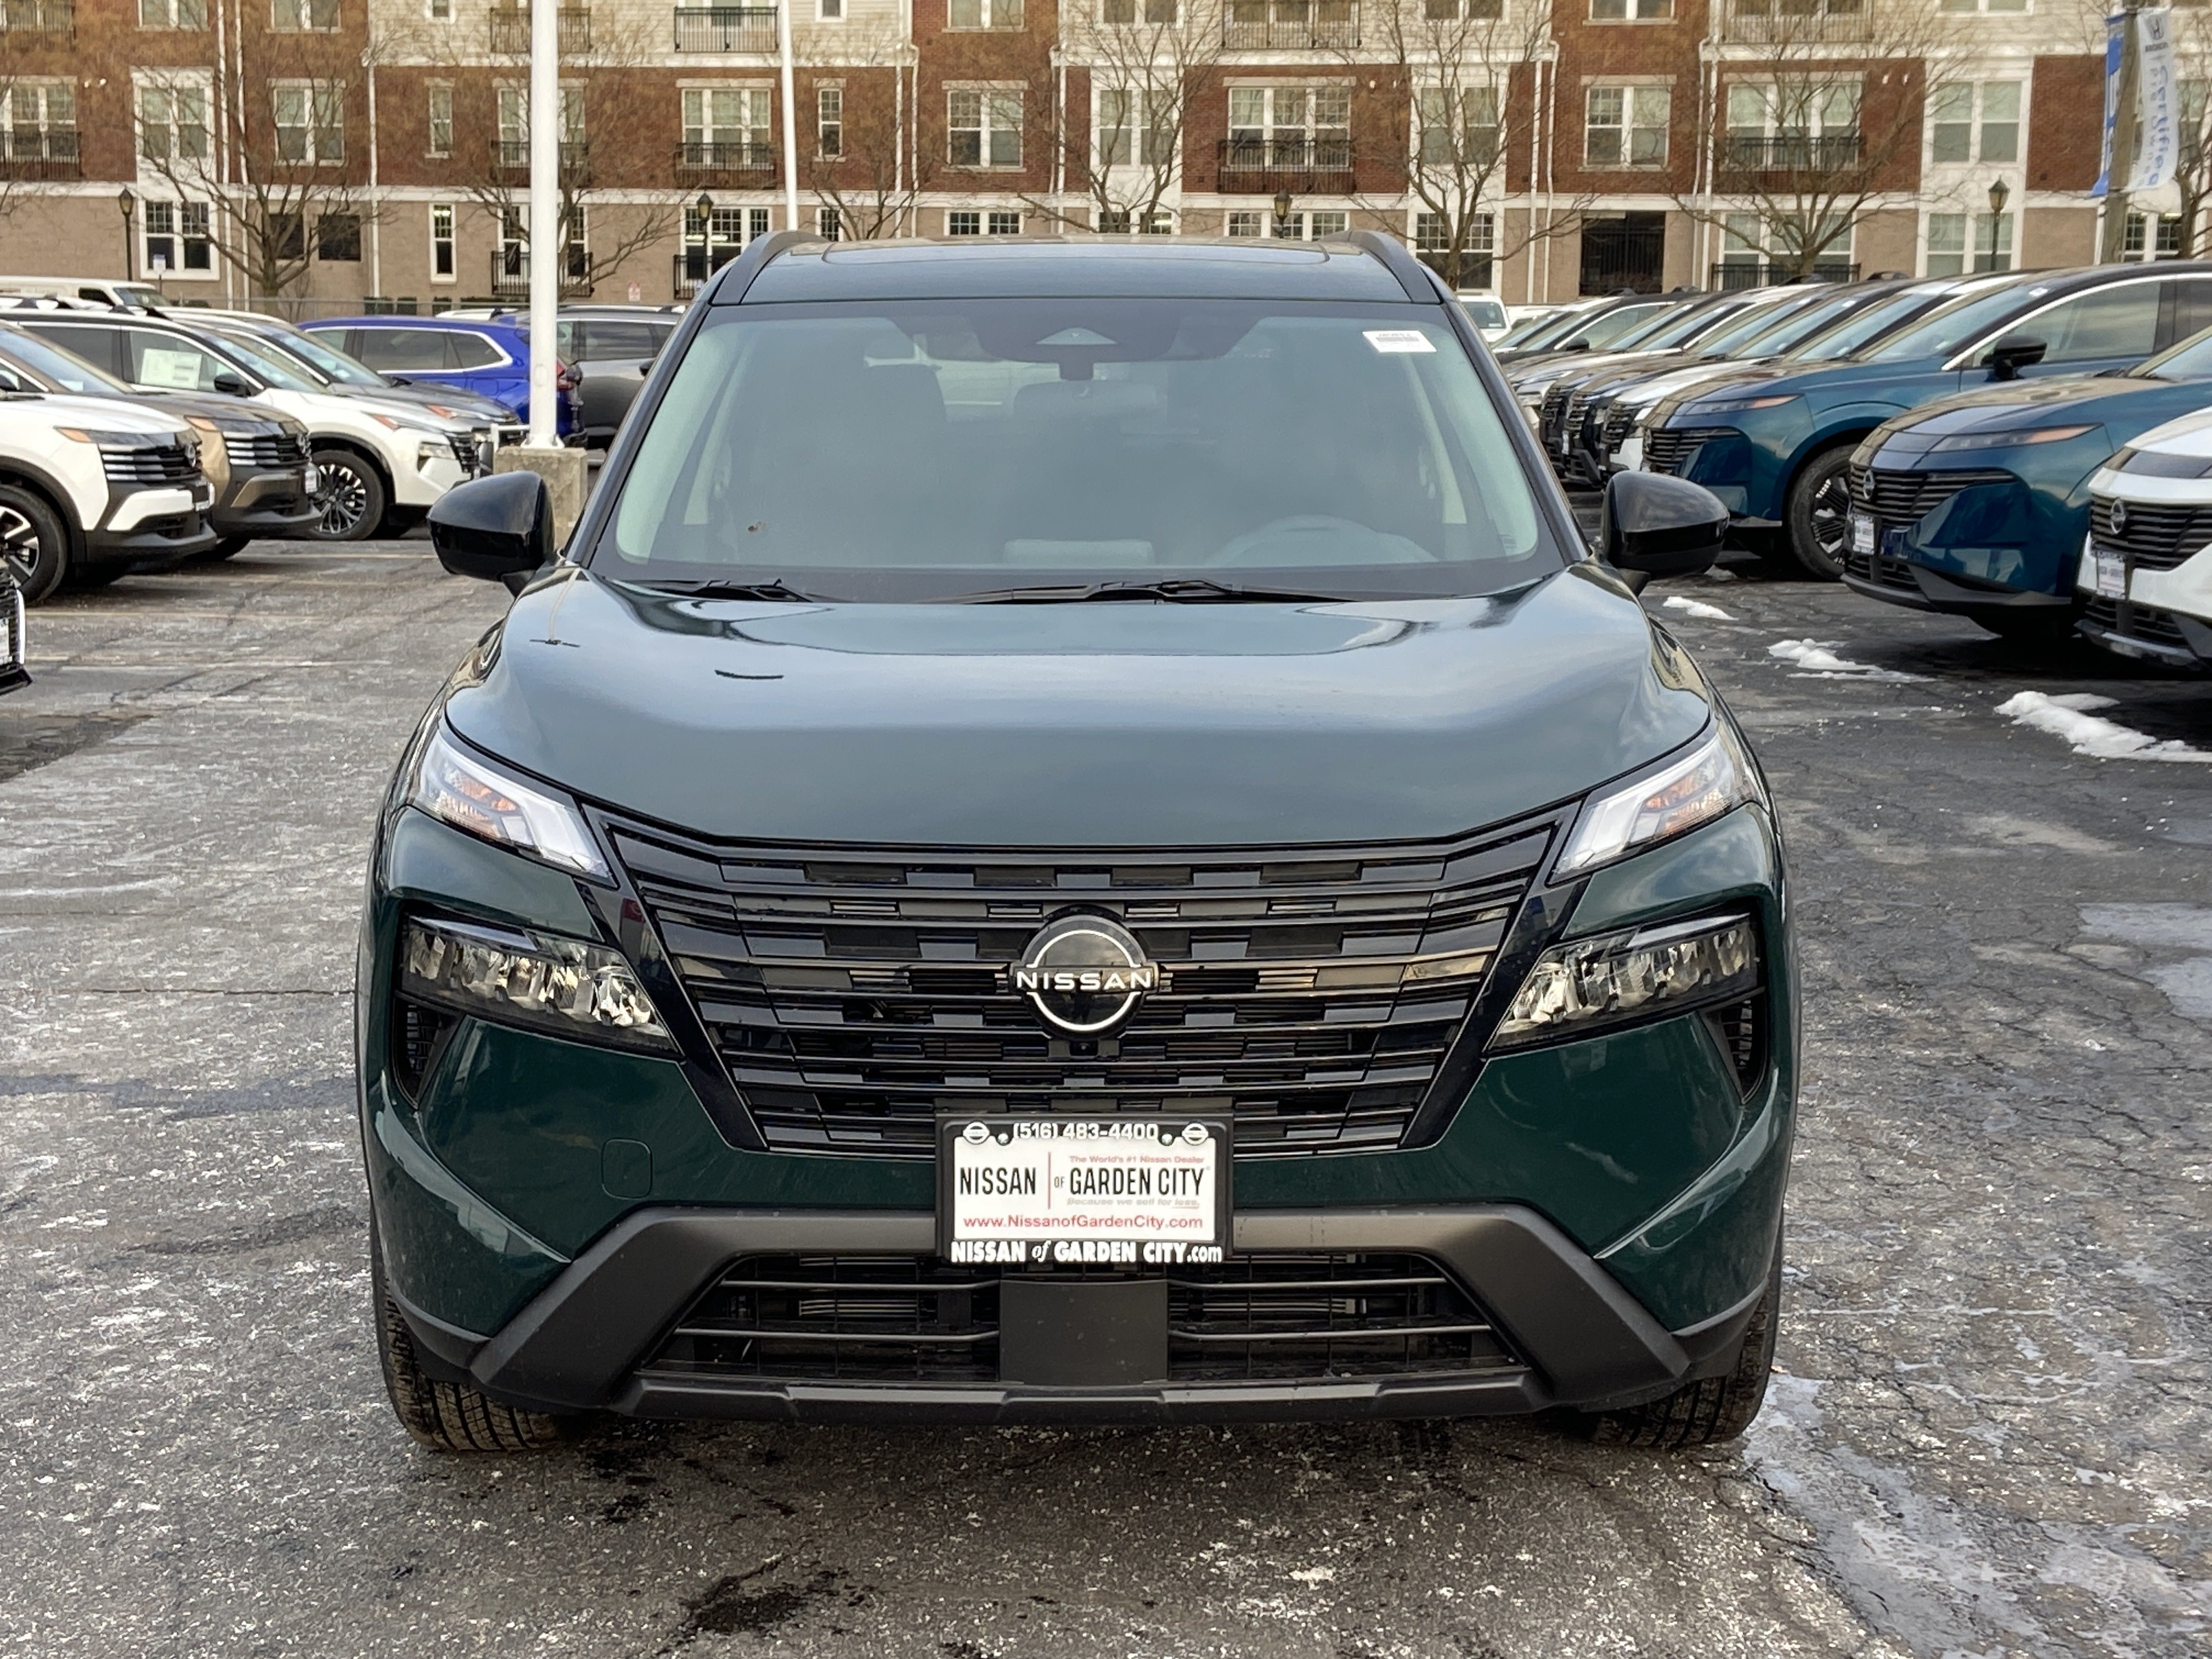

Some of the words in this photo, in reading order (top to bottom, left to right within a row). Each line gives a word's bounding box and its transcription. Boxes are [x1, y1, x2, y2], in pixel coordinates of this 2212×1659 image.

[1016, 970, 1151, 991] NISSAN
[1013, 1122, 1058, 1139] (516)
[1062, 1122, 1158, 1140] 483-4400
[1174, 1155, 1204, 1164] Dealer
[960, 1167, 1036, 1195] NISSAN
[1054, 1176, 1065, 1188] OF
[1070, 1167, 1151, 1195] GARDEN
[1158, 1167, 1205, 1196] CITY
[963, 1214, 1203, 1230] www.NissanofGardenCity.com
[951, 1240, 1026, 1263] NISSAN
[1031, 1240, 1052, 1262] of
[1054, 1241, 1136, 1262] GARDEN
